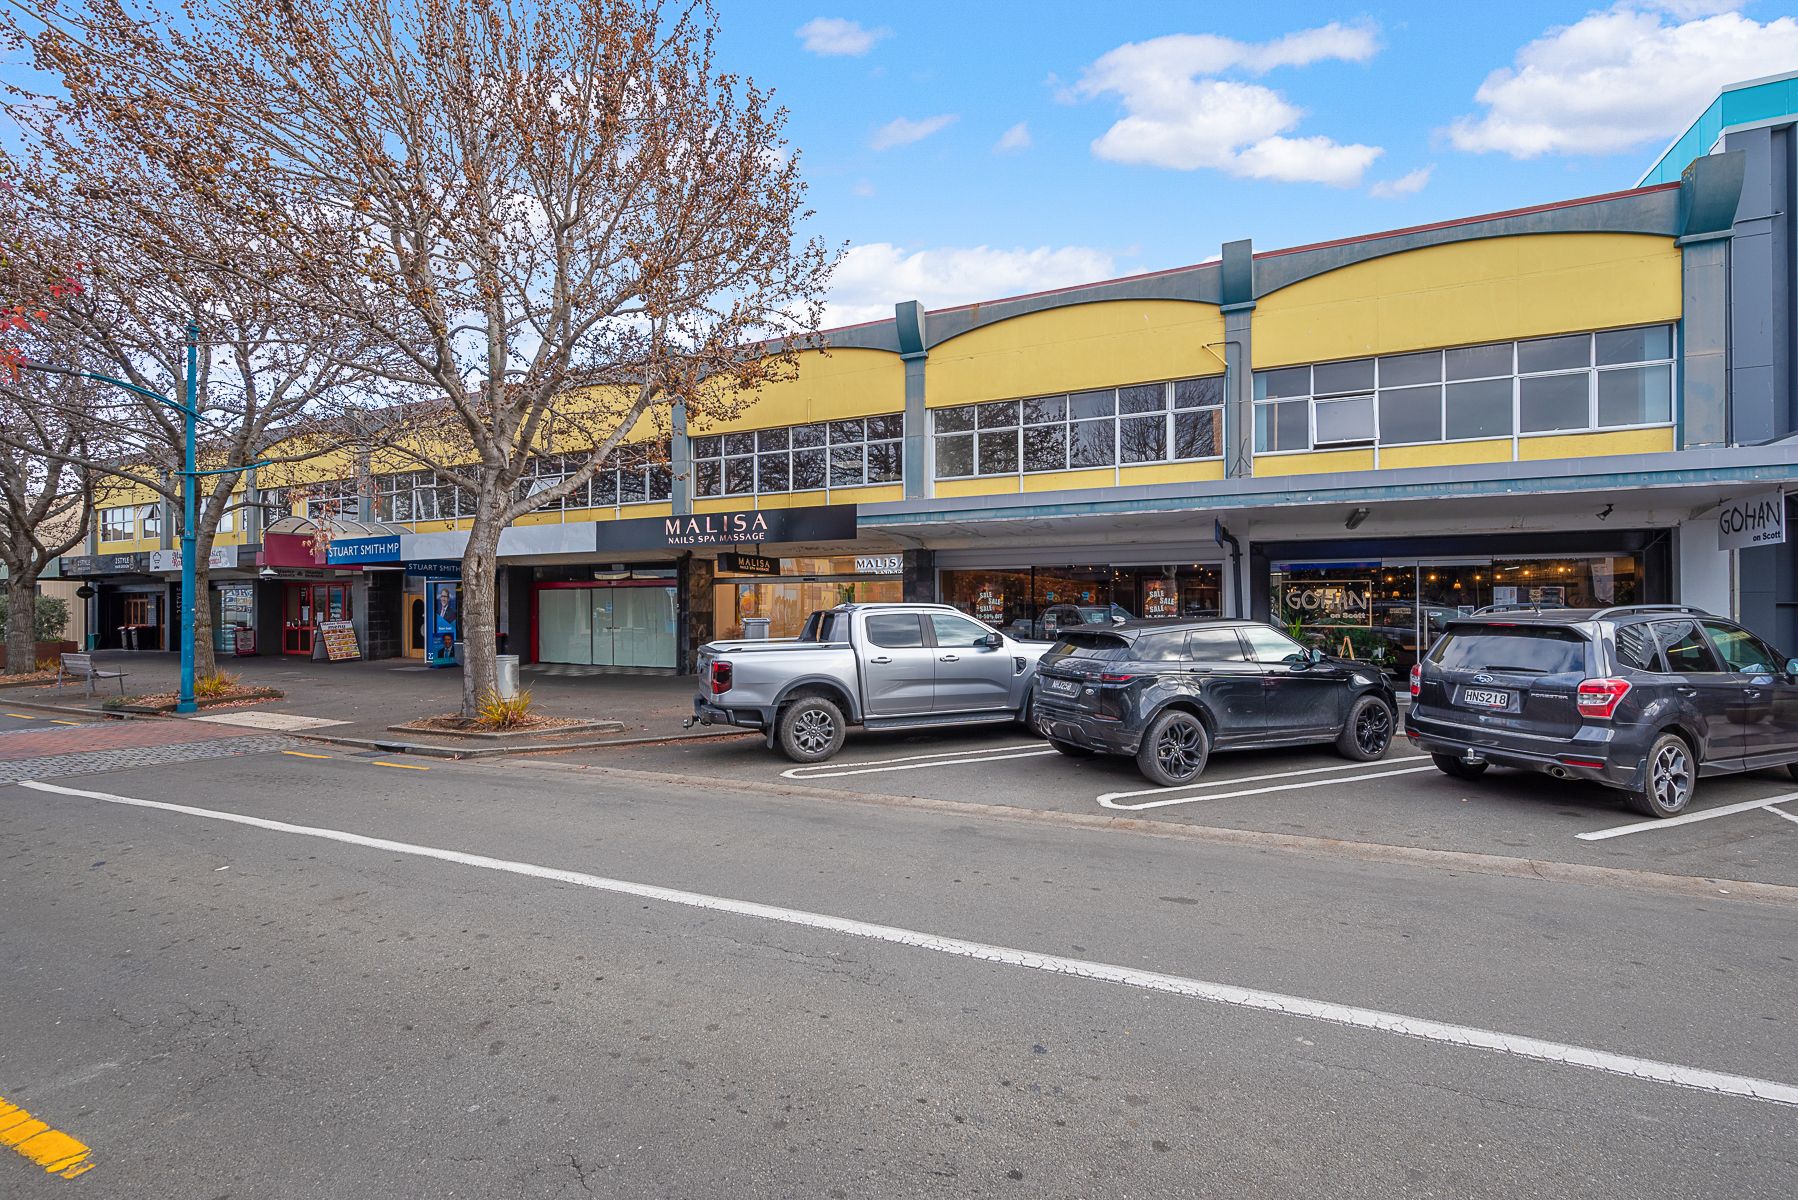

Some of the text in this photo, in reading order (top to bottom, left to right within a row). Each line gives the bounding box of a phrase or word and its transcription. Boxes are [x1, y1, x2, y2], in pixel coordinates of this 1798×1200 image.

[665, 512, 768, 535] MALISA
[1720, 501, 1780, 535] GOHAN
[668, 532, 765, 545] NAILS SPA MASSAGE
[1762, 531, 1781, 540] Scott
[328, 542, 400, 558] STUART SMITH MP
[408, 563, 460, 572] STUART SMITH
[738, 557, 771, 569] MALISA
[1149, 590, 1165, 598] SALE
[1285, 589, 1367, 610] GOHAN
[1160, 597, 1175, 605] SALE
[1149, 604, 1165, 612] SALE
[1465, 690, 1506, 704] HNS218
